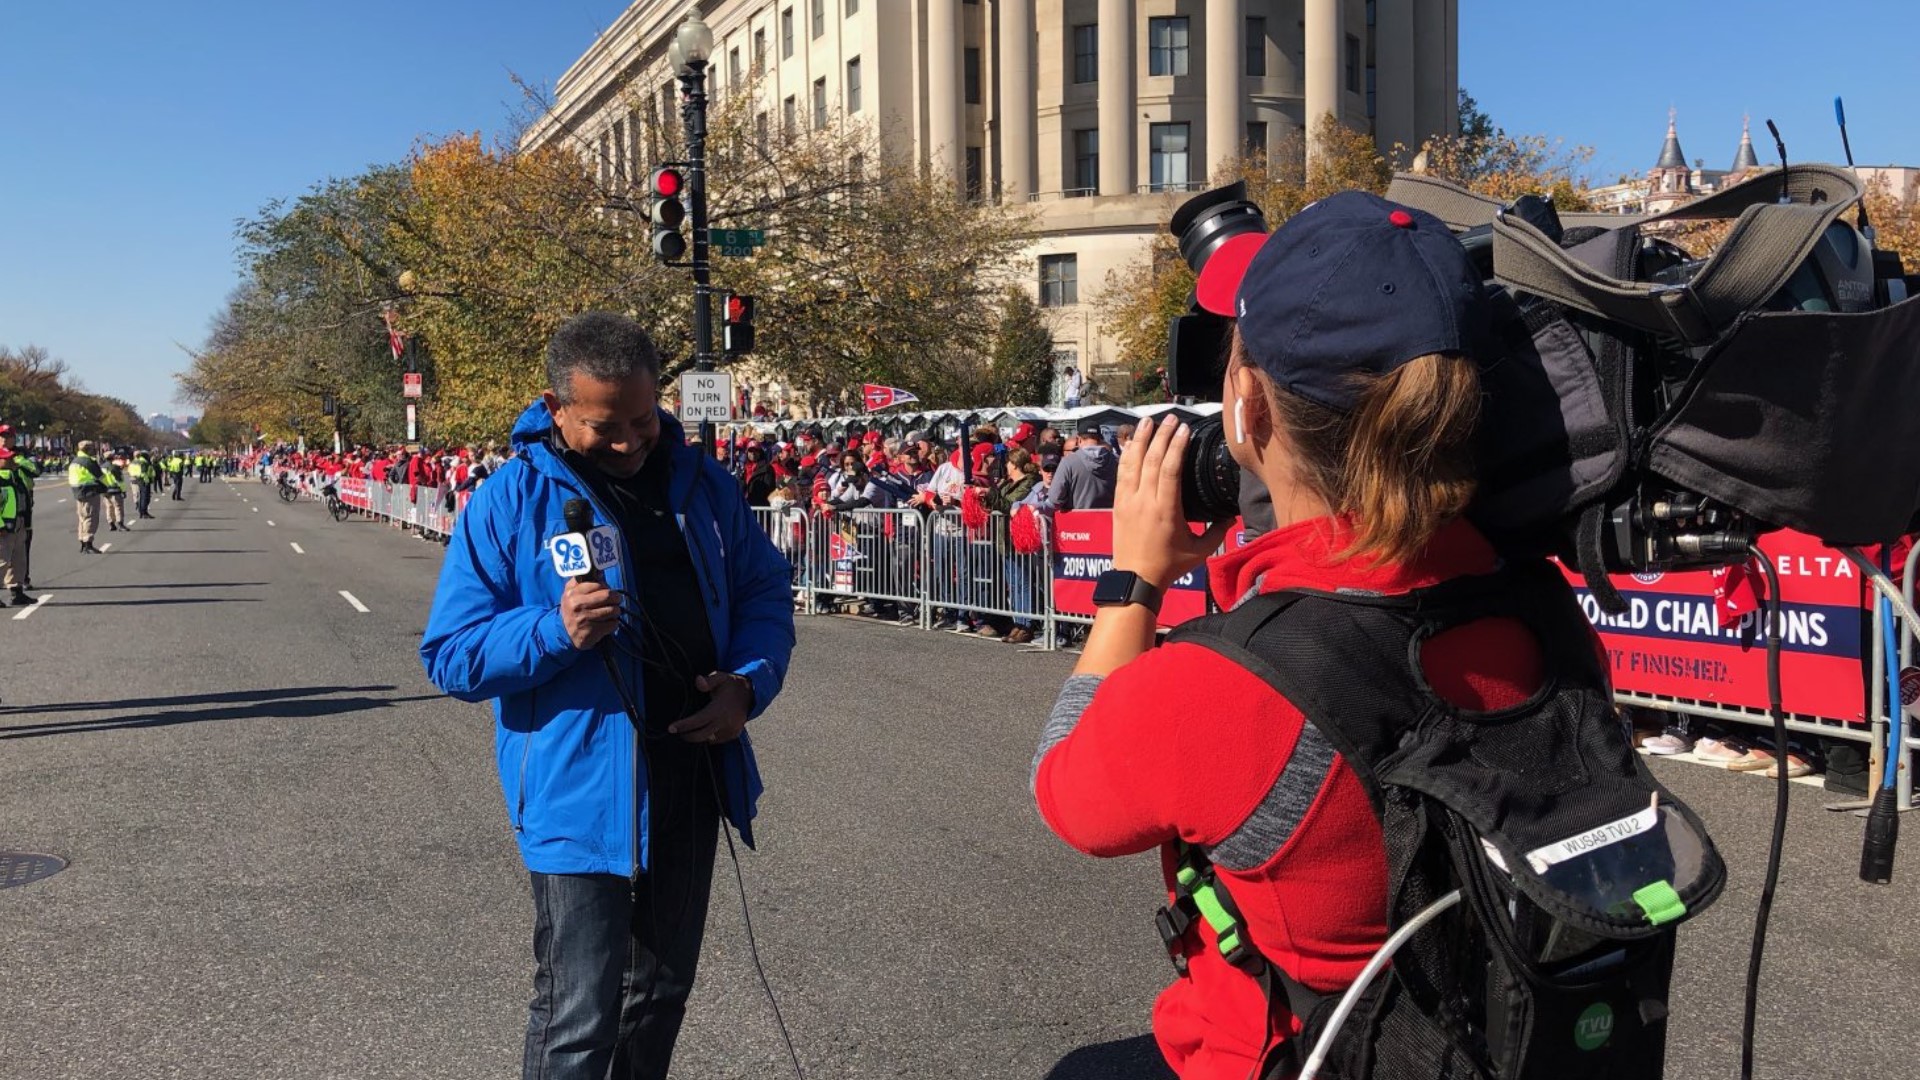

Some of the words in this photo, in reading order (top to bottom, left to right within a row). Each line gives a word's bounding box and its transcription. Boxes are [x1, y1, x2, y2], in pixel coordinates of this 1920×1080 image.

[725, 231, 737, 244] 6
[724, 246, 752, 256] 200
[697, 379, 715, 389] NO
[692, 392, 720, 403] TURN
[686, 406, 702, 416] ON
[705, 406, 727, 417] RED
[560, 561, 587, 573] WUSA
[1063, 556, 1085, 577] 2019
[1086, 557, 1114, 577] WOR
[1630, 651, 1734, 684] FINISHED.
[1562, 830, 1608, 854] WUSA9
[1605, 819, 1632, 839] TVU
[1631, 818, 1642, 831] 2
[1580, 1014, 1612, 1035] TVU
